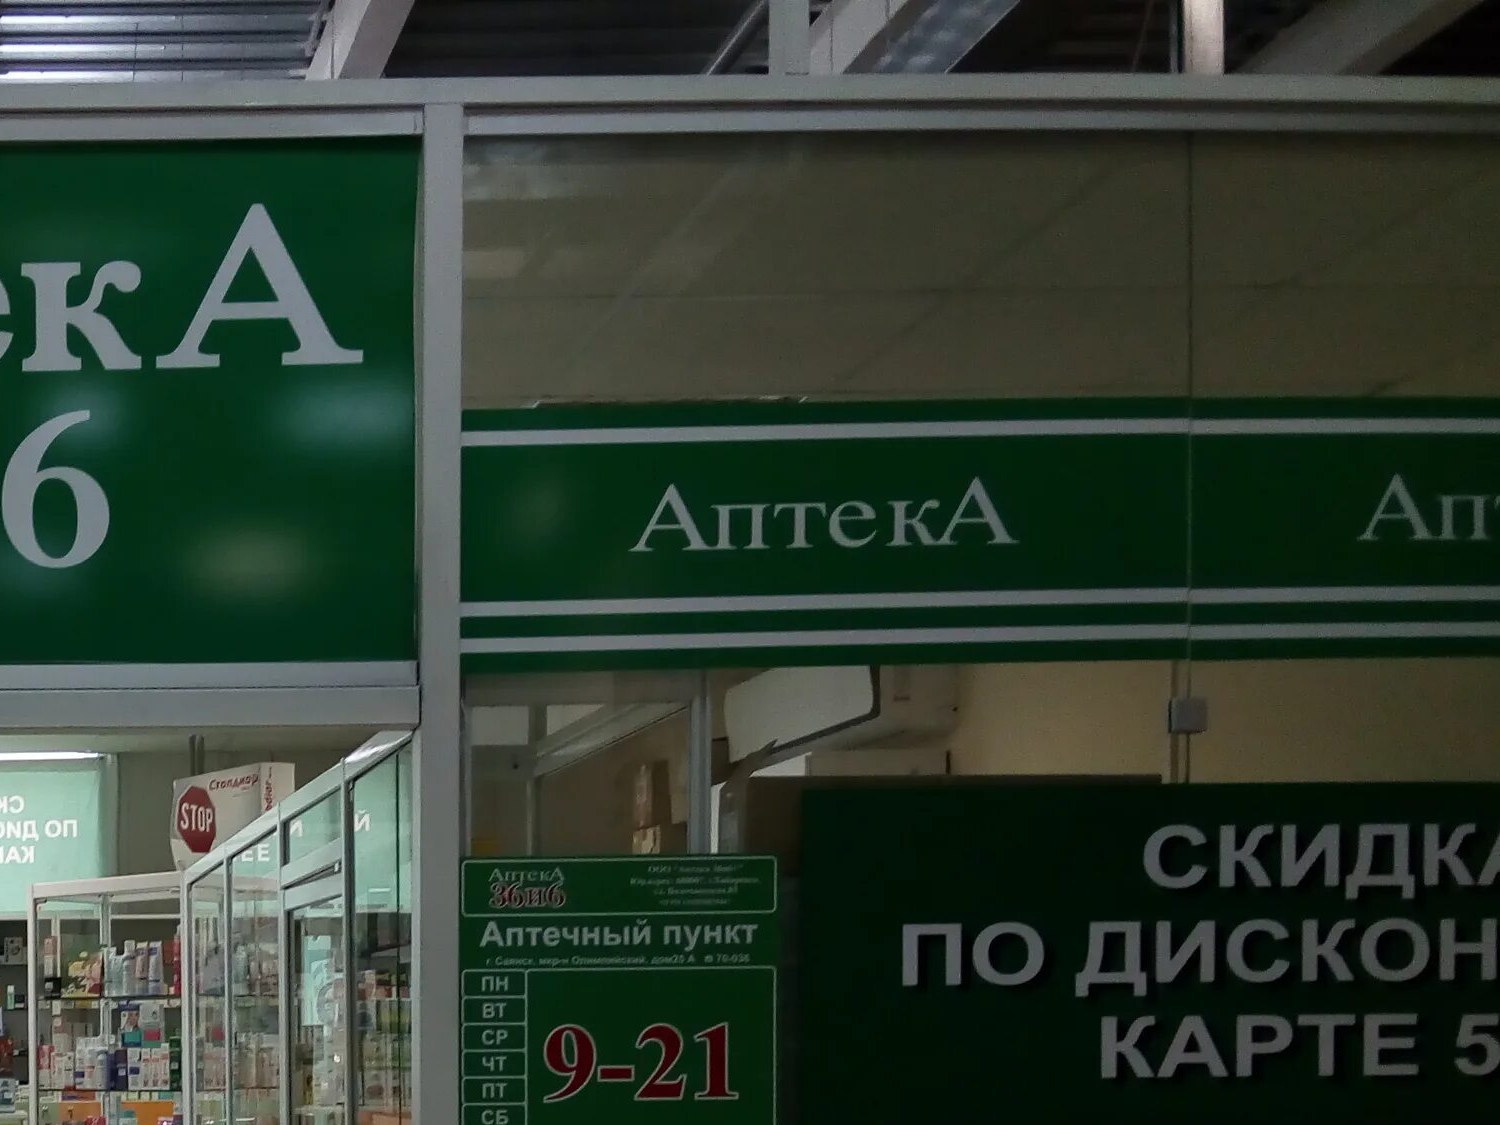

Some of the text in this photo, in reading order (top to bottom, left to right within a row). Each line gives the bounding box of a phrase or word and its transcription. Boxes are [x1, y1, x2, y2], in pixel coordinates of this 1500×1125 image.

[627, 475, 1020, 553] АптекА
[1355, 472, 1500, 542] Ап
[180, 802, 214, 833] STOP
[1143, 822, 1500, 900] СКИДК
[480, 918, 759, 951] Аптечный пункт
[902, 920, 1045, 987] ПО
[481, 975, 509, 992] ПН
[481, 1002, 507, 1019] ВТ
[481, 1029, 509, 1045] СР
[1100, 1012, 1420, 1080] КАРТЕ
[481, 1056, 507, 1072] ЧТ
[543, 1021, 740, 1103] 9-21
[481, 1083, 508, 1099] ПТ
[481, 1110, 509, 1125] СБ
